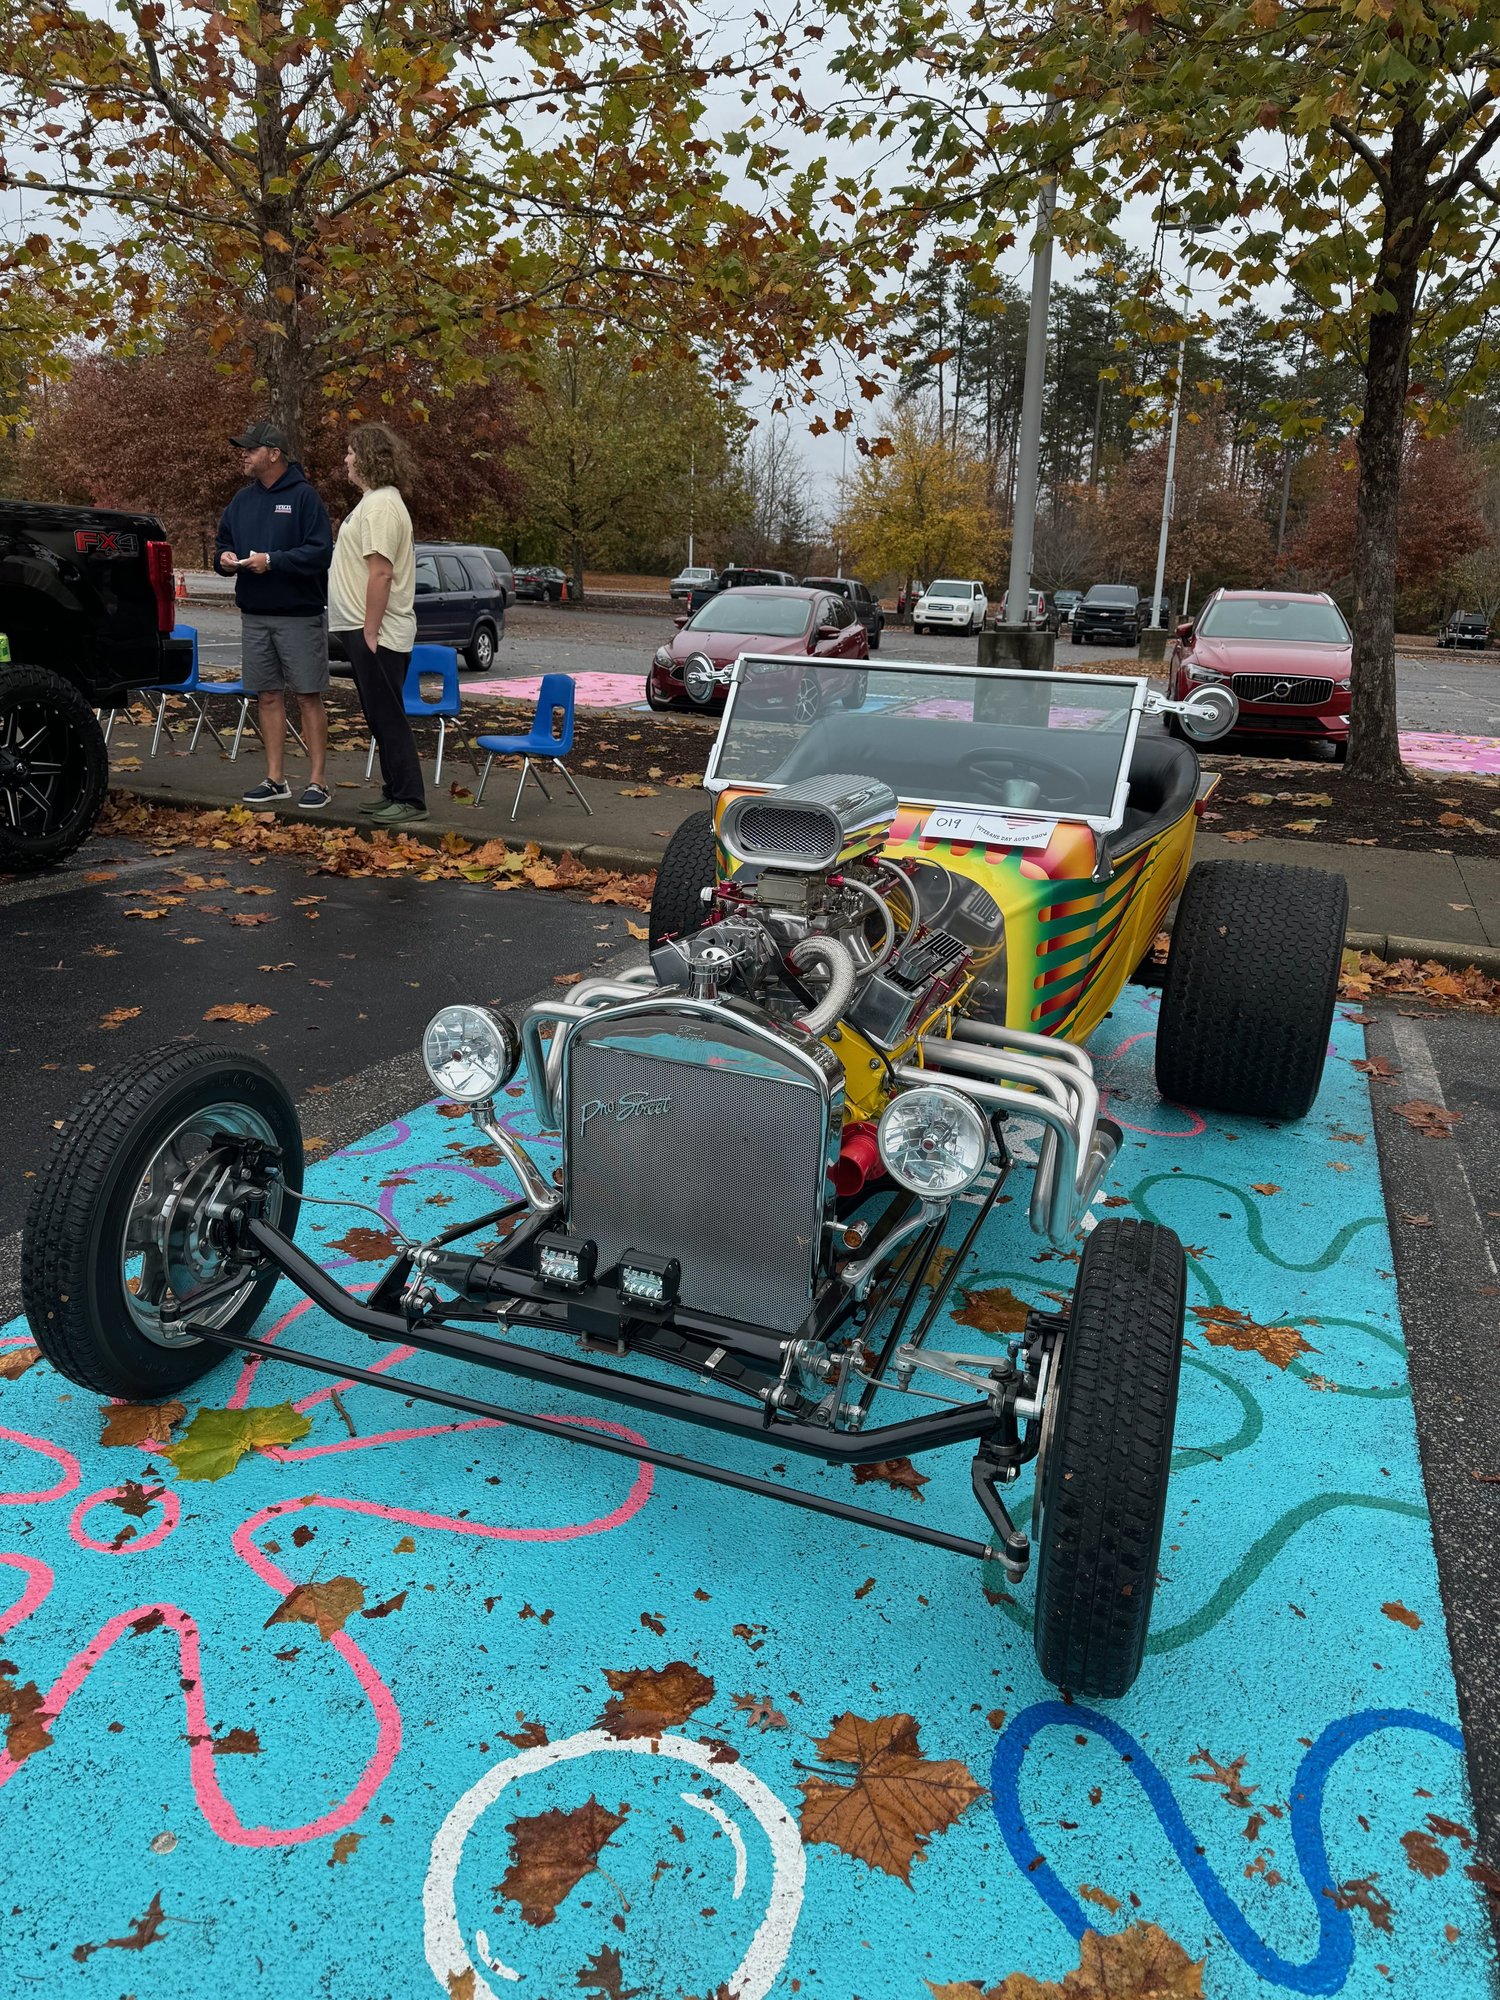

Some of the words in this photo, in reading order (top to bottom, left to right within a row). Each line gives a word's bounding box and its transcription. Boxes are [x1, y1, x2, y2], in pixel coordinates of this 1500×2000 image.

[74, 529, 139, 554] FX4
[936, 817, 962, 829] 019
[976, 824, 1001, 840] VETERANS
[1031, 831, 1048, 840] SHOW
[581, 1099, 615, 1137] Pro
[616, 1090, 671, 1121] Street
